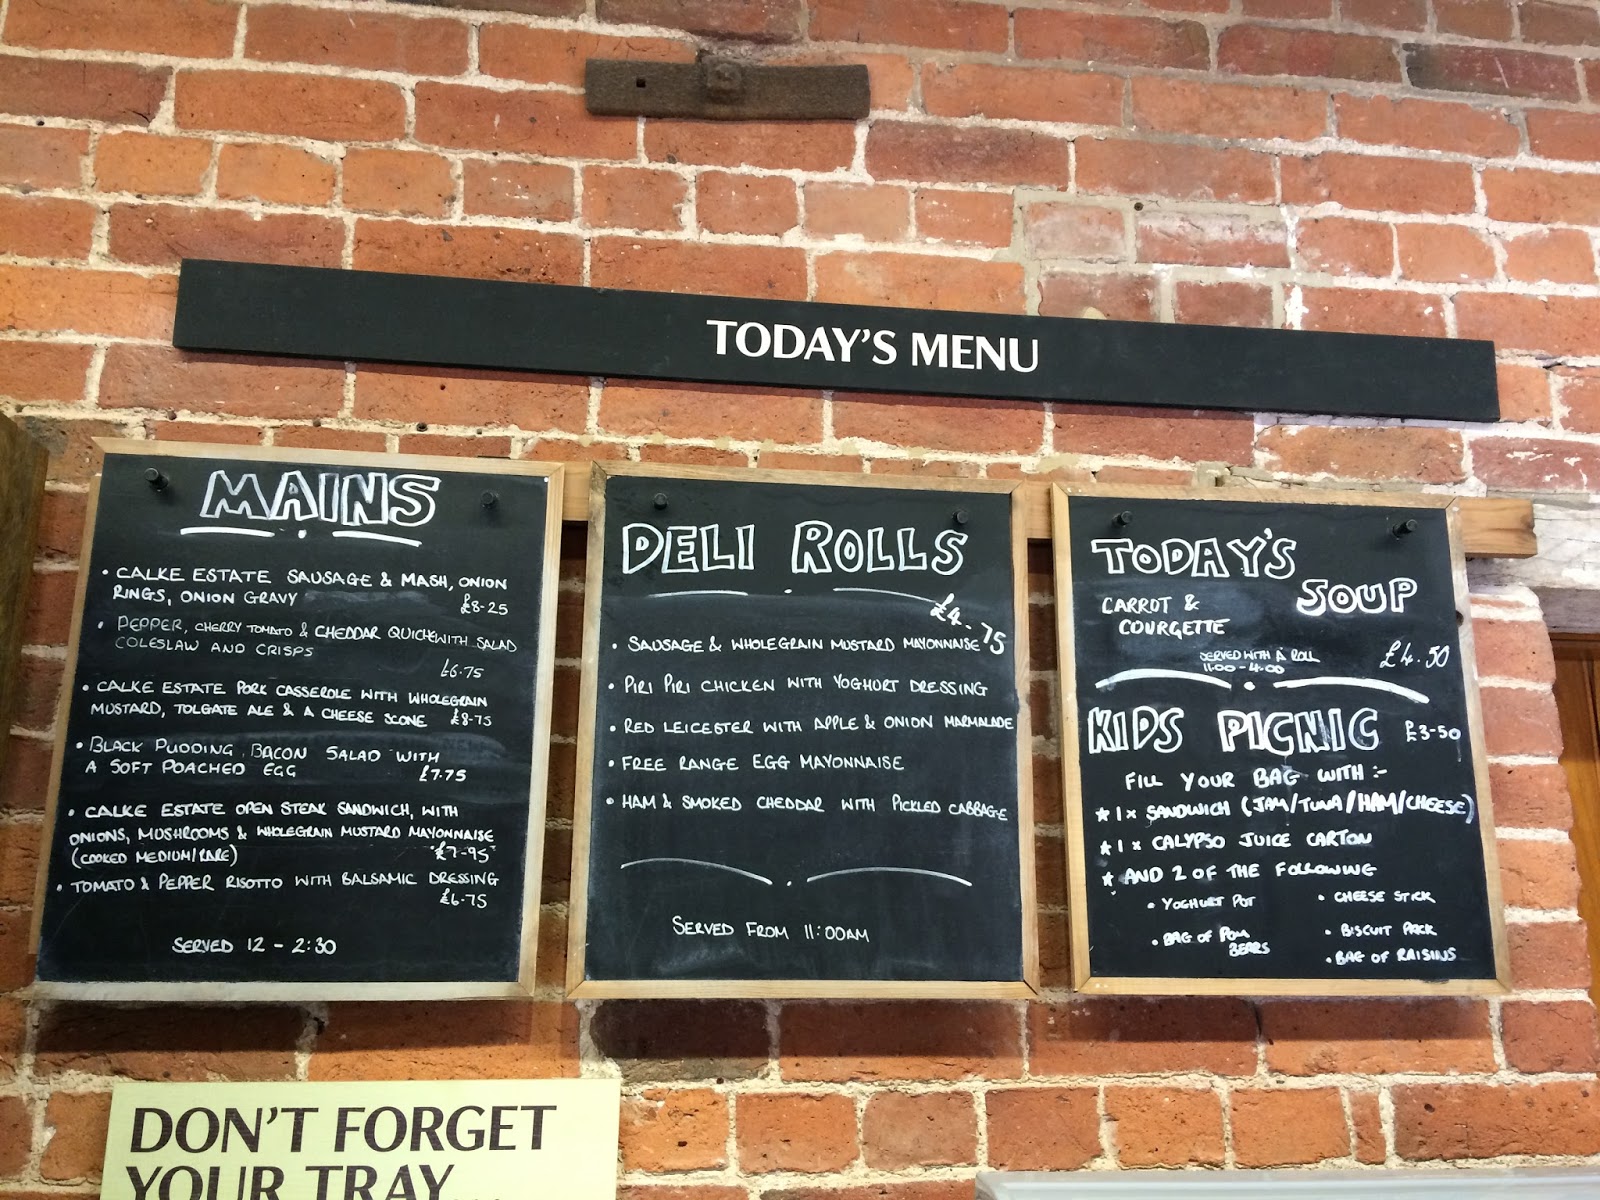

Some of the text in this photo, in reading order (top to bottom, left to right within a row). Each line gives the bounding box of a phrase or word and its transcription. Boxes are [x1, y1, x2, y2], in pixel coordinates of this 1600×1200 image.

[707, 320, 1038, 372] TODAY'S MENU
[200, 470, 441, 526] MAINS
[623, 521, 968, 575] DELI ROLLS
[1091, 528, 1296, 579] TODAY'S
[117, 567, 507, 591] CALKE ESTATE SAUSAGE & MASH, ONION
[113, 585, 297, 606] RINGS, ONION GRAVY
[1102, 594, 1200, 614] CARROT &
[1296, 578, 1417, 616] SOUP
[118, 616, 187, 634] PEPPER,
[195, 621, 242, 632] CHERRY
[247, 625, 292, 636] TOMATO
[300, 622, 307, 637] &
[315, 626, 381, 640] CHEDDAR
[477, 637, 517, 652] SALAD
[1119, 619, 1230, 639] COURGETTE
[116, 637, 313, 656] COLESLAW AND CRISPS
[628, 636, 980, 652] SAUSAGE & WHOLEGRAIN MUSTARD MAYONNAISE
[1244, 650, 1270, 660] WITH
[1276, 650, 1286, 662] A
[1291, 649, 1320, 662] ROLL
[97, 680, 487, 707] CALKE ESTATE PORK CASSEROLE WITH WHOLEGRAIN
[625, 674, 987, 696] PIRI PIRI CHICKEN WITH YOGHURT DRESSING
[91, 701, 427, 727] MUSTARD, TOLGATE ALE & A CHEESE SCONE
[625, 714, 1014, 734] RED LEICESTER WITH APPLE & ONION MARMALADE
[1088, 706, 1379, 758] KIDS PICNIC
[90, 736, 439, 762] BLACK BACON SALAD WITH
[86, 759, 295, 777] A SOFT POACHED EGG
[622, 754, 904, 771] FREE RANGE EGG MAYONNAISE
[1126, 764, 1364, 791] FILL YOUR BAG WITH
[85, 802, 458, 819] CALKE ESTATE OPEN STEAK SANDWICH, WITH
[622, 793, 1007, 820] HAM & SMOKED CHEDDAR WITH PICKLED CABBAGE
[1146, 801, 1230, 823] SANDWICH
[69, 826, 493, 845] ONIONS, MUSHROOMS & WHOLEGRAIN MUSTARD MAYONNAISE
[1152, 829, 1372, 850] CALYPSO JUICE CARTON
[72, 847, 127, 868] (COOKED
[71, 872, 499, 892] TOMATO & PEPPER RISOTTO WITH BALSAMIC DRESSING
[1122, 862, 1377, 884] AND 2 OF THE FOLLOWING
[1162, 894, 1255, 910] YOGHURT POT
[1334, 891, 1435, 903] CHEESE STICK
[673, 916, 869, 942] SERVED FROM 11:00AM
[1163, 931, 1192, 946] BAG
[1197, 930, 1212, 943] OF
[1341, 922, 1437, 937] BISCUIT PACK
[172, 937, 233, 953] SERVED
[248, 937, 265, 952] 12
[292, 937, 336, 954] 2:30
[1229, 942, 1270, 956] BEARS
[1335, 947, 1456, 965] BAG OF RAISINS
[131, 1106, 557, 1153] DON'T FORGET
[126, 1166, 284, 1200] YOUR
